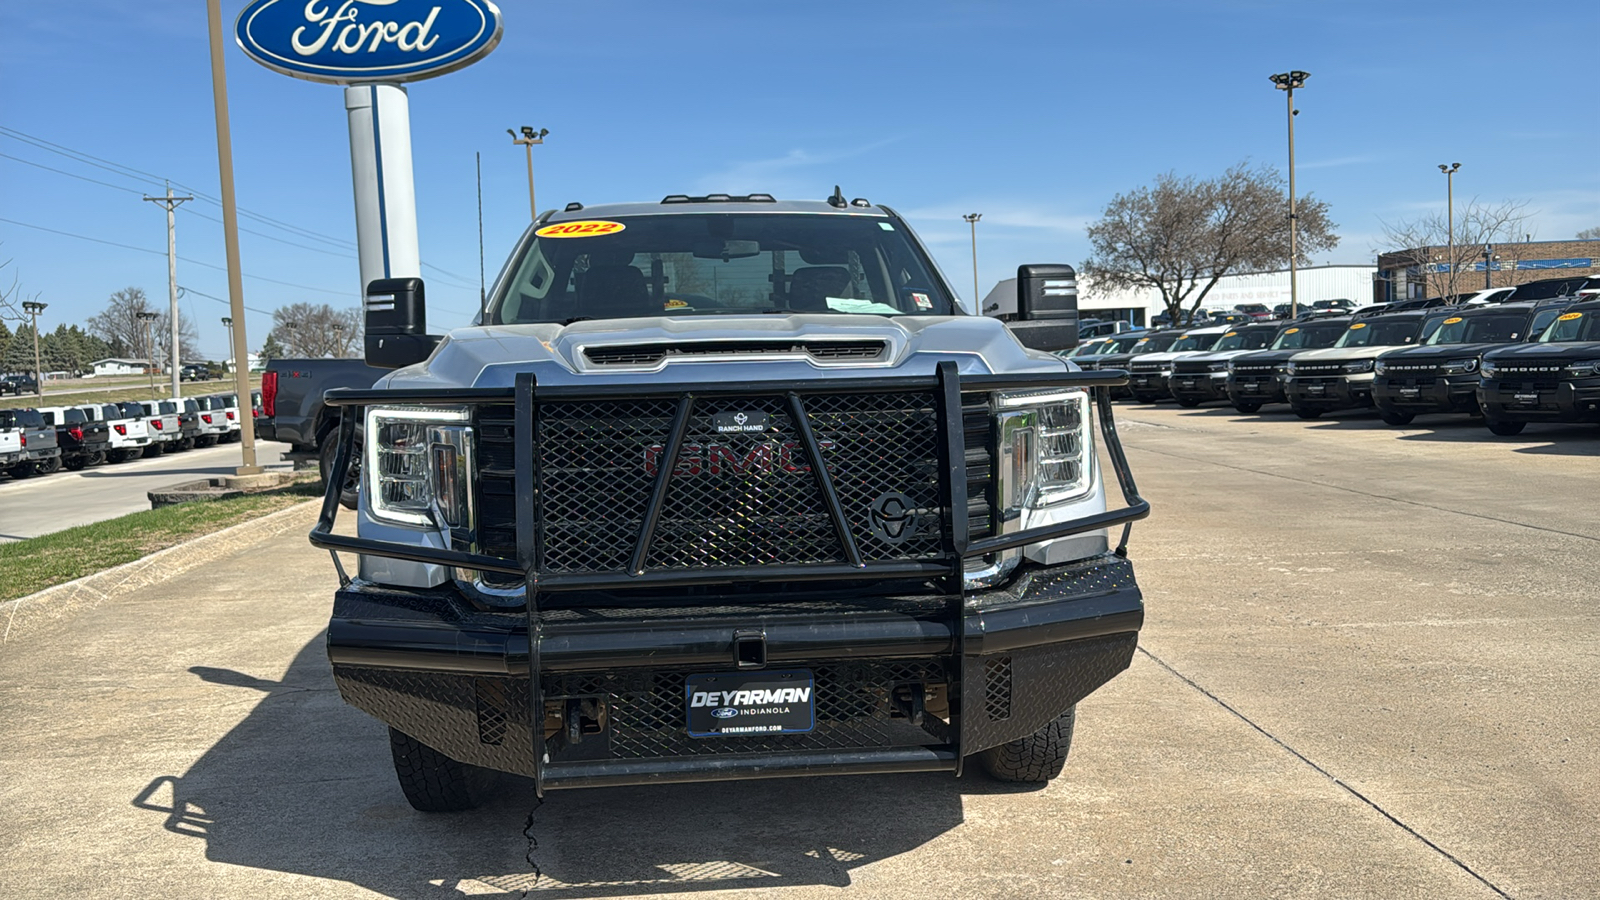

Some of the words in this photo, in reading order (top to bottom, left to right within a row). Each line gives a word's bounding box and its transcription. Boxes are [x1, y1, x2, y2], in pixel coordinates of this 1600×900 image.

[291, 0, 442, 56] Ford
[543, 223, 618, 235] 2022
[644, 442, 836, 477] GMC
[690, 687, 811, 708] DEYARMAN
[740, 707, 790, 716] INDIANOLA
[721, 725, 782, 734] DEYARMANFORD.COM
